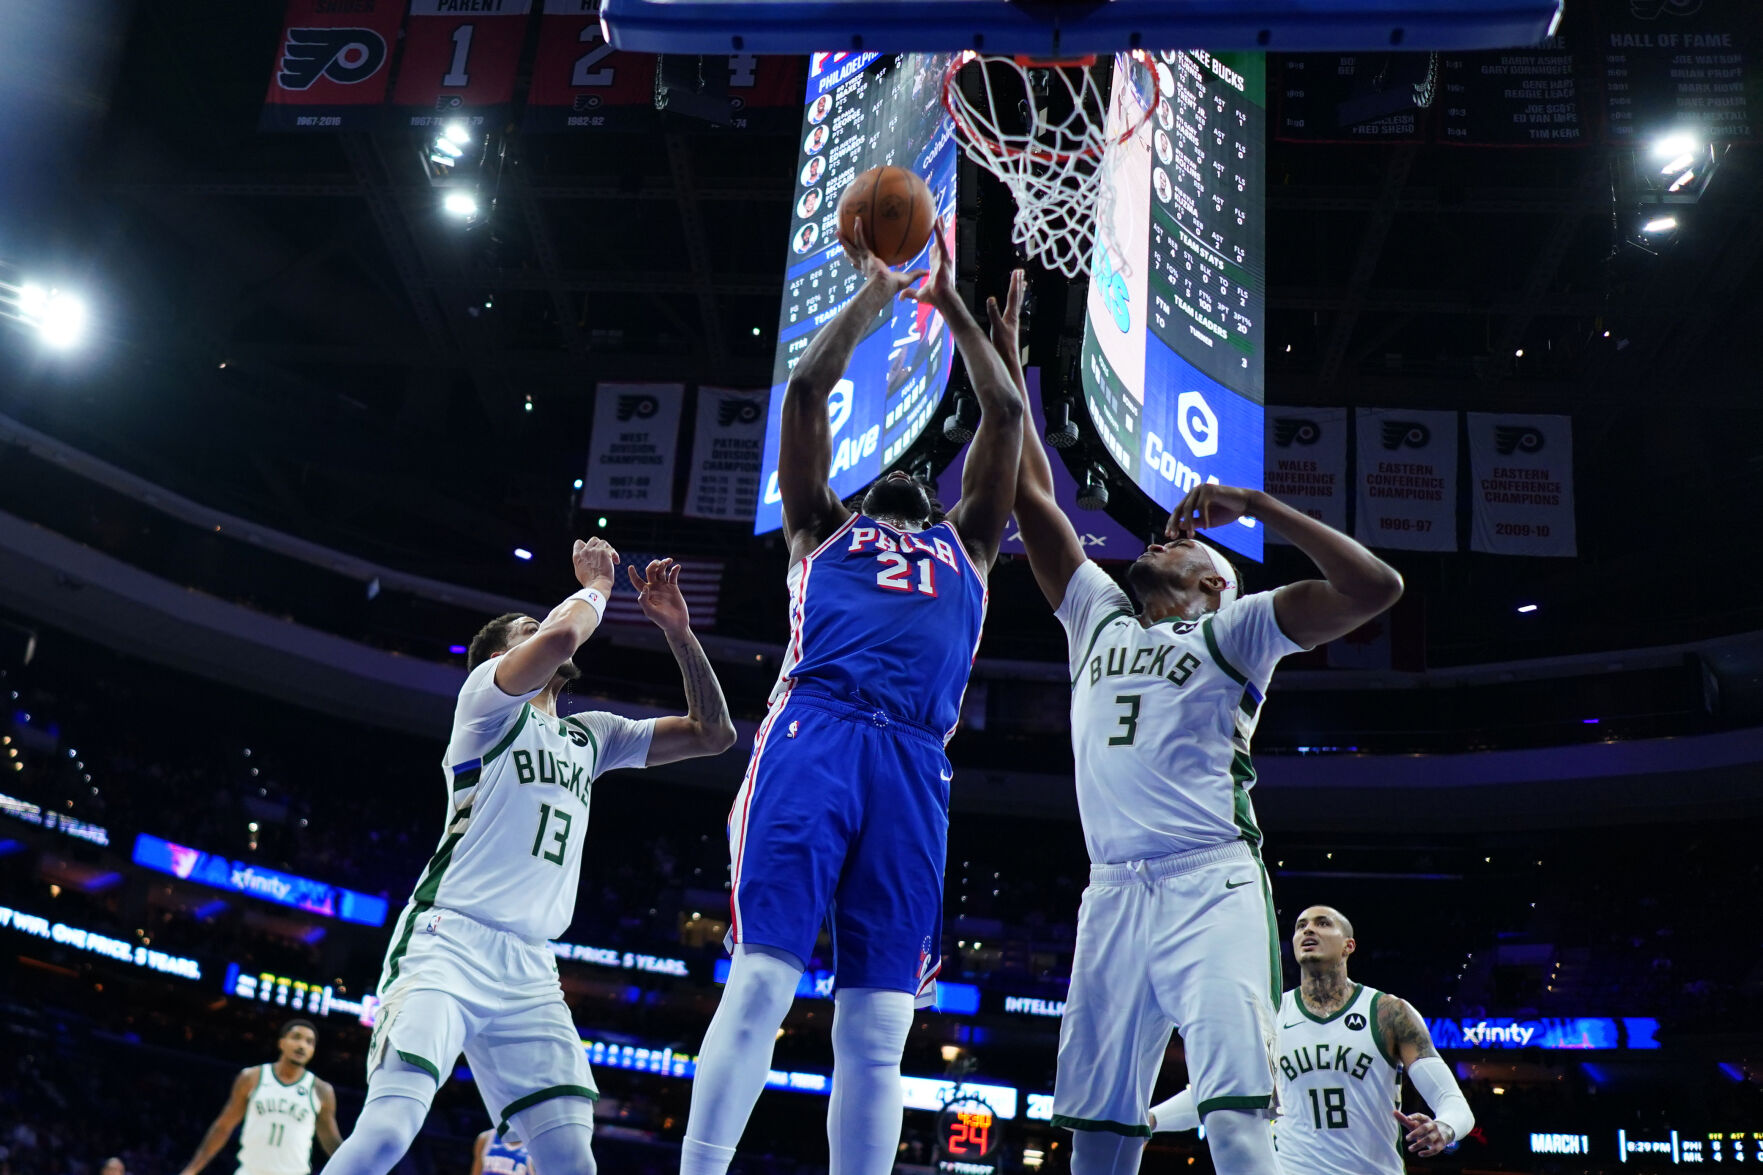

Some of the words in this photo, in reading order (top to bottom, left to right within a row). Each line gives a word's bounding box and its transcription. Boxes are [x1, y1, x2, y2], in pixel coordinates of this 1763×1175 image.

[1610, 33, 1654, 48] HALL
[1657, 33, 1681, 48] OF
[1683, 33, 1733, 48] FAME
[442, 24, 475, 87] 1
[571, 23, 617, 87] 2
[1211, 57, 1245, 92] BUCKS
[1214, 95, 1226, 108] AST
[1236, 109, 1247, 122] FLS
[1213, 128, 1225, 141] AST
[1235, 141, 1247, 154] FLS
[1213, 160, 1225, 174] AST
[1235, 173, 1246, 187] FLS
[1174, 192, 1199, 218] KUZMA
[1212, 193, 1225, 207] AST
[1234, 207, 1246, 220] FLS
[1179, 230, 1200, 254] TEAM
[1200, 246, 1225, 270] STATS
[1211, 231, 1224, 244] AST
[1234, 245, 1246, 258] FLS
[1199, 263, 1212, 277] BLK
[1218, 275, 1229, 287] TO
[1237, 287, 1249, 299] FLS
[1155, 295, 1170, 315] FTM
[1173, 294, 1195, 318] TEAM
[1195, 310, 1228, 339] LEADERS
[1198, 298, 1212, 313] 100
[1236, 322, 1248, 335] 20
[1155, 313, 1165, 329] TO
[702, 461, 760, 472] CHAMPION
[1278, 460, 1318, 472] WALES
[1378, 461, 1434, 476] EASTERN
[1492, 467, 1550, 481] EASTERN
[1366, 473, 1446, 488] CONFERENCE
[1368, 485, 1443, 501] CHAMPIONS
[1481, 479, 1562, 494] CONFERENCE
[1485, 491, 1560, 506] CHAMPIONS
[1379, 517, 1433, 533] 1996-97
[1495, 522, 1550, 539] 2009-10
[876, 550, 939, 599] 21
[1089, 643, 1203, 689] BUCKS
[1107, 694, 1142, 747] 3
[512, 748, 593, 809] BUCKS
[531, 802, 573, 867] 13
[230, 867, 292, 900] xfinity
[1462, 1021, 1535, 1047] xfinity
[1279, 1043, 1374, 1083] BUCKS
[255, 1097, 311, 1123] BUCKS
[1307, 1087, 1350, 1131] 18
[267, 1121, 285, 1148] 11
[948, 1123, 989, 1156] 24
[1530, 1133, 1580, 1156] MARCH
[1580, 1134, 1589, 1156] 1
